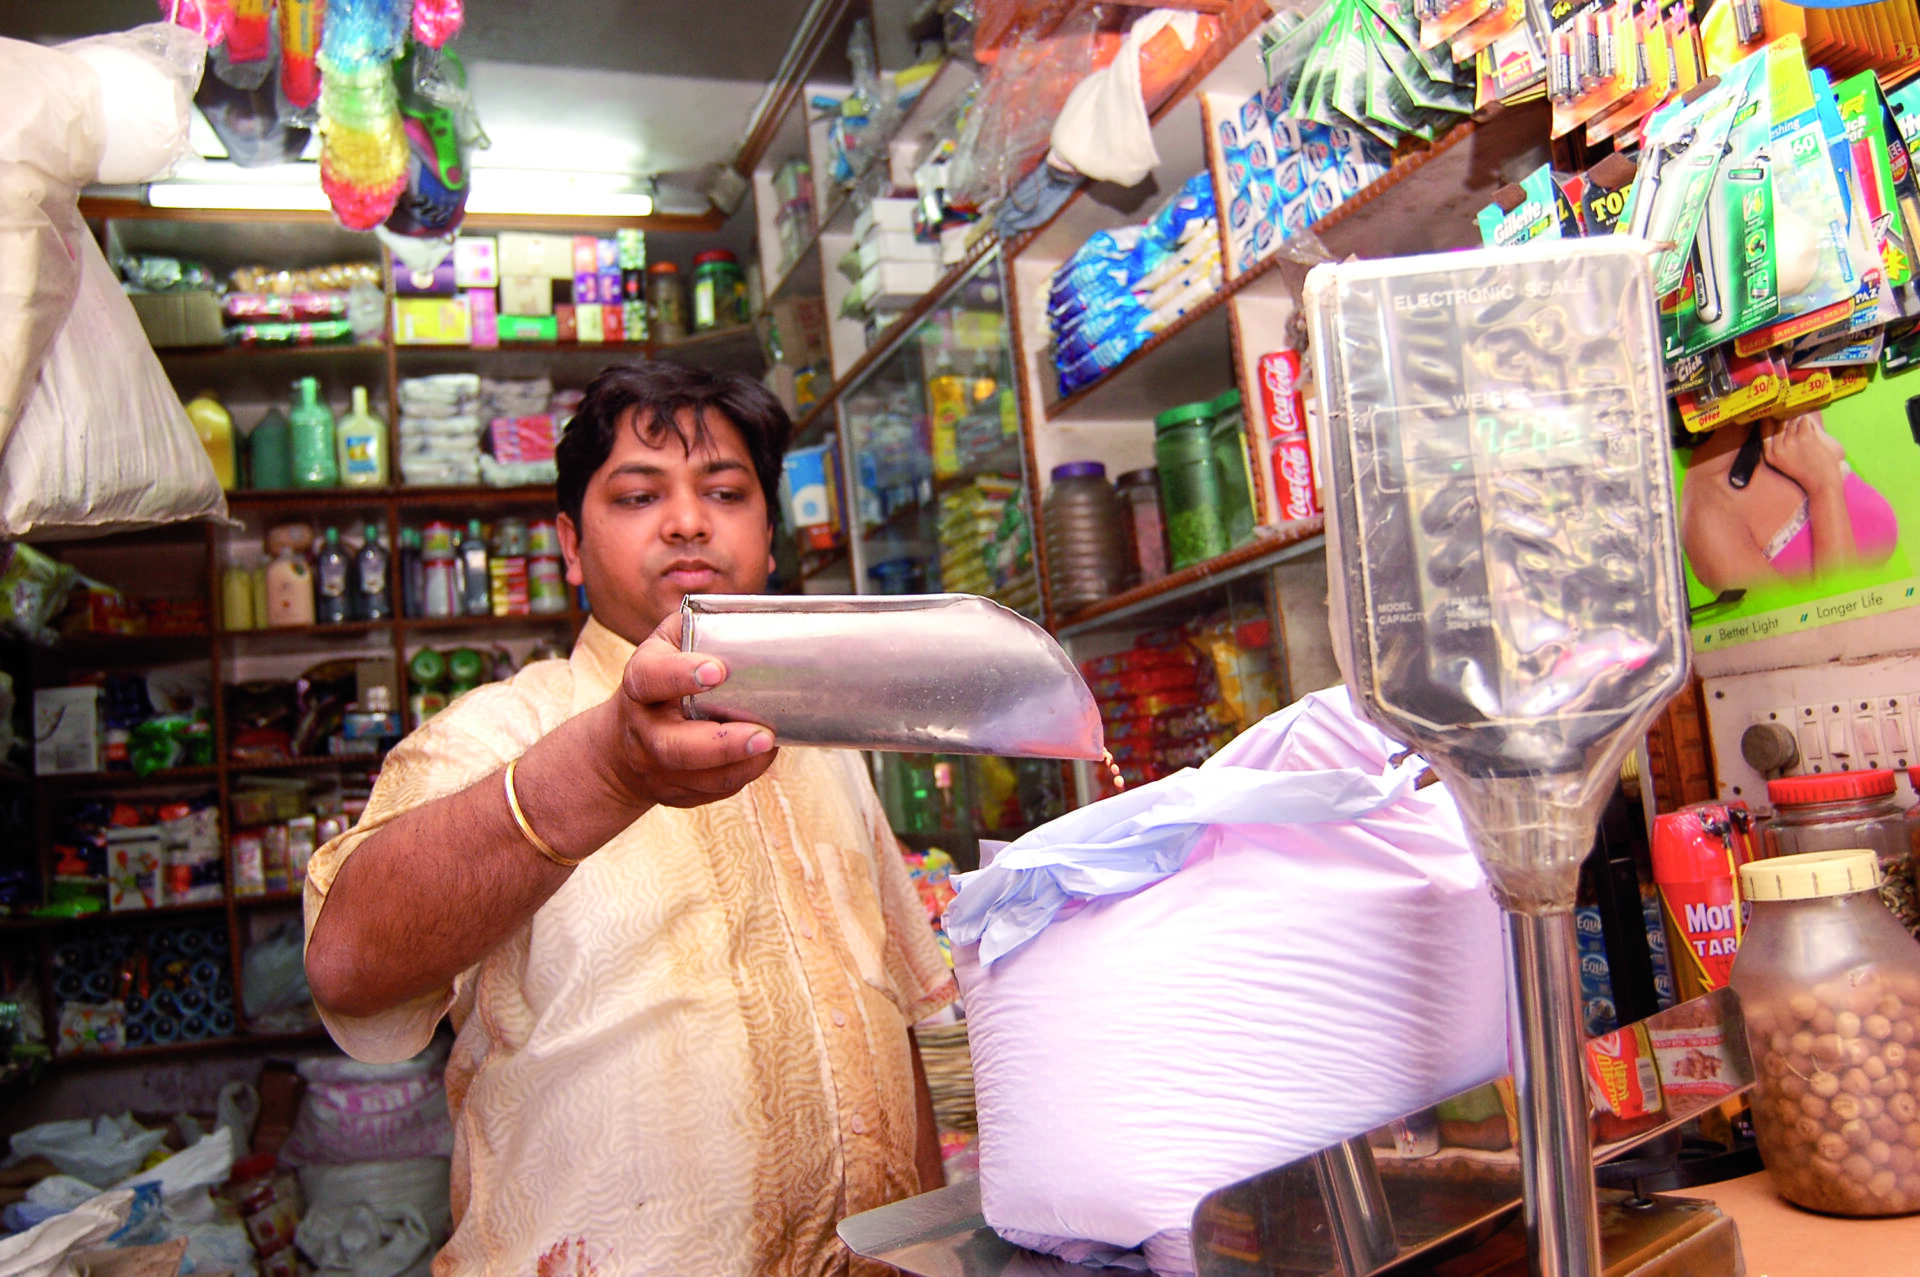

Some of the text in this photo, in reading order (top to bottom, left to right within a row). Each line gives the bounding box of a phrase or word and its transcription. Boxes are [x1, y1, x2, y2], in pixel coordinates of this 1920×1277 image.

[1494, 201, 1543, 245] Gillette
[1394, 278, 1588, 310] ELECTRONIC SCALE
[1771, 324, 1798, 340] CARE
[1799, 316, 1822, 330] FOR
[1823, 306, 1849, 320] MEN
[1378, 602, 1414, 613] MODEL
[1718, 593, 1885, 641] Better Light Longer Life
